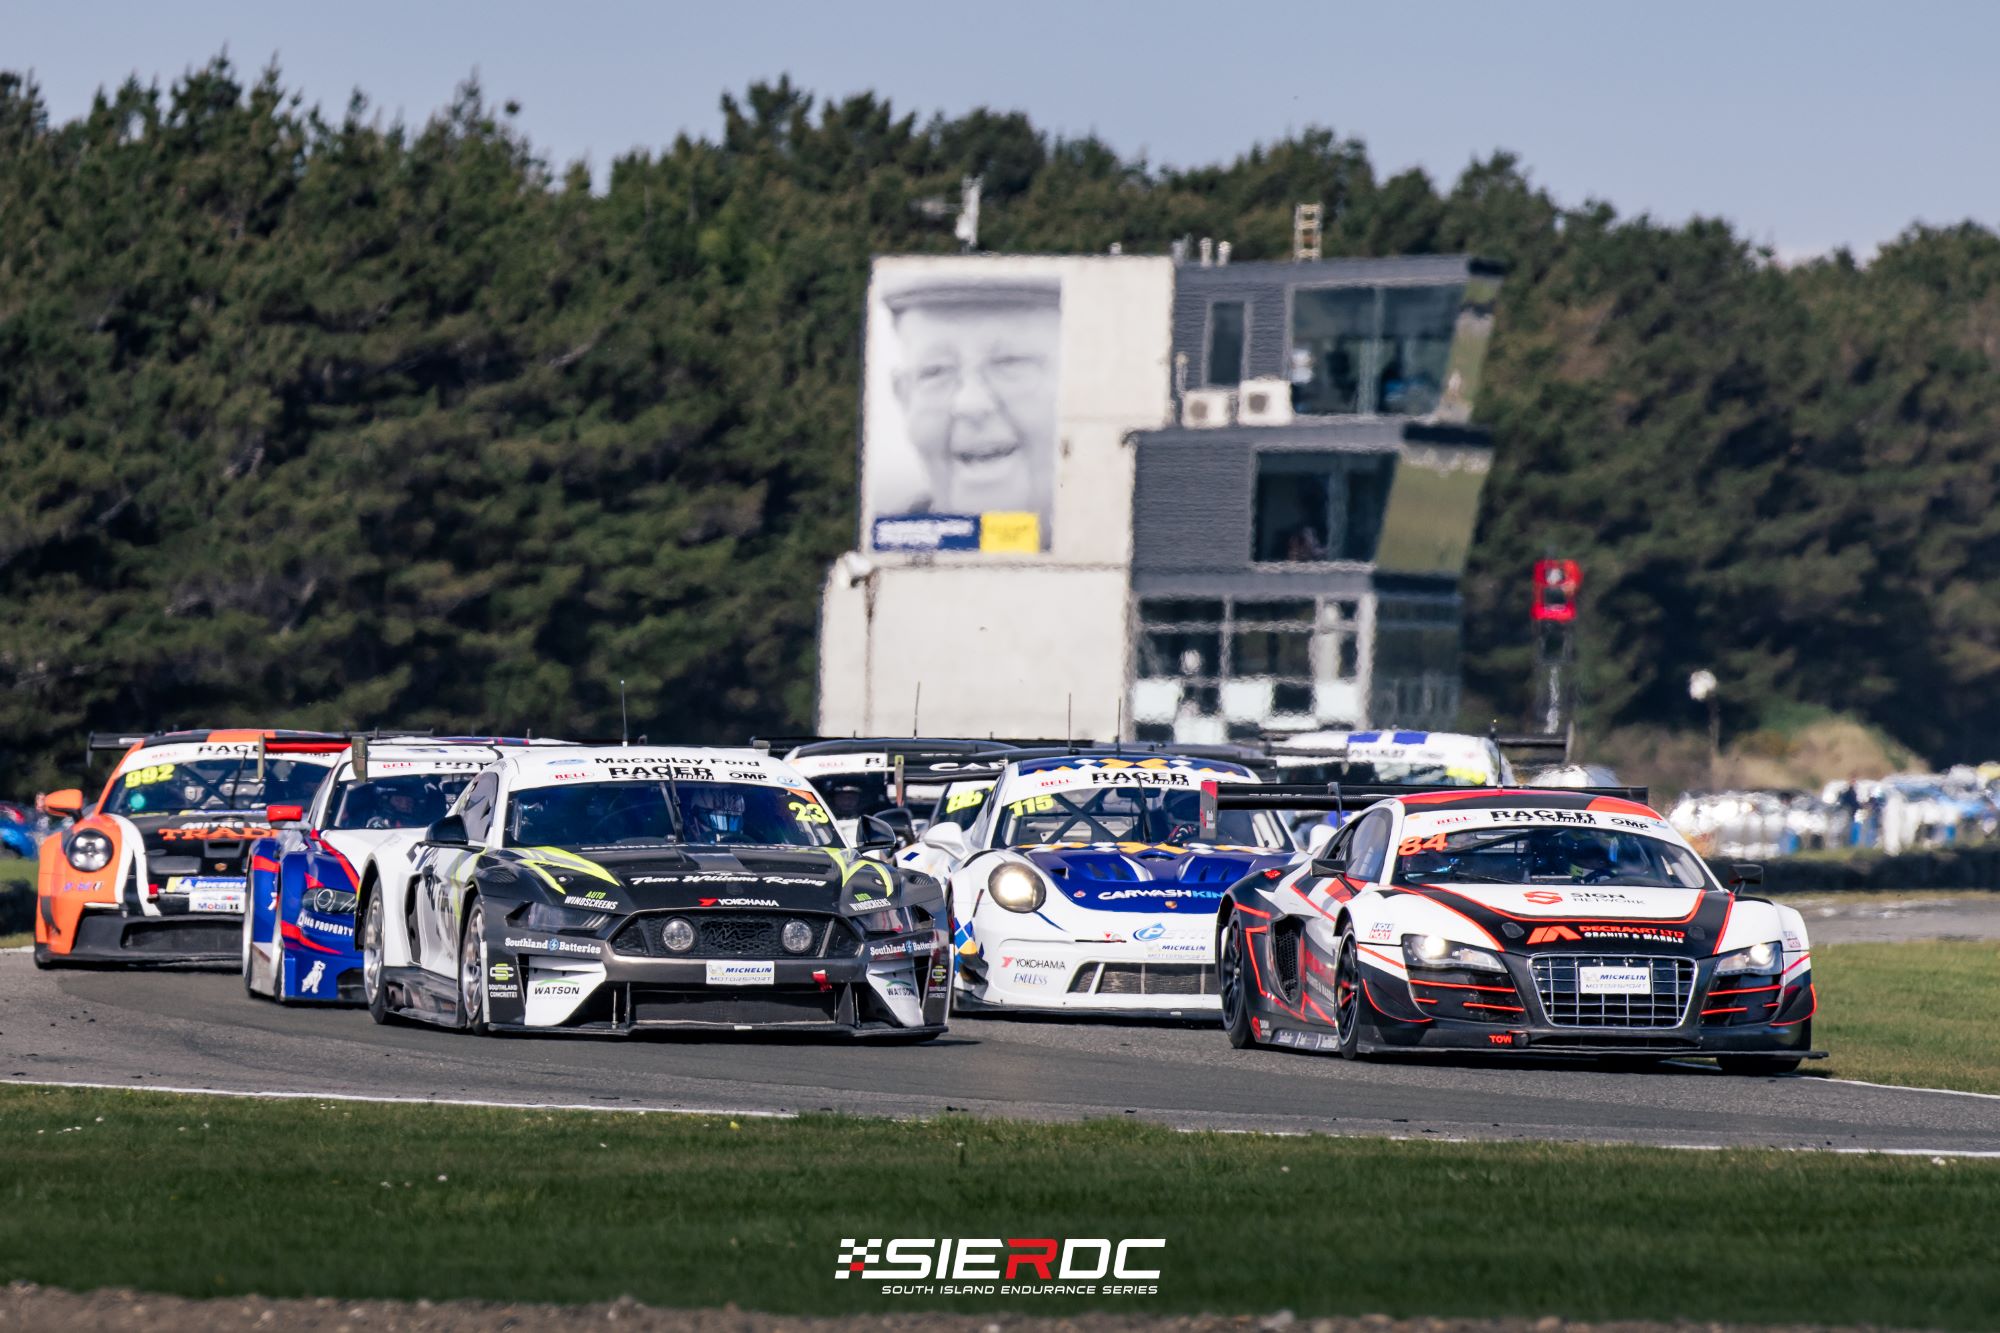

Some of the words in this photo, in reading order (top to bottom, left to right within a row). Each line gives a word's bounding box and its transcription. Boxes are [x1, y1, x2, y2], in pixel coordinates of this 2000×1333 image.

[595, 757, 703, 766] Macaulay
[710, 758, 760, 767] Ford
[125, 763, 175, 788] 992
[555, 772, 586, 780] BELL
[608, 766, 711, 776] RACER
[729, 771, 768, 780] OMP
[1091, 771, 1189, 783] RACER
[1041, 778, 1071, 787] BELL
[1009, 793, 1054, 817] 115
[788, 801, 829, 824] 23
[1490, 809, 1593, 821] RACER
[1436, 815, 1472, 825] BELL
[1610, 817, 1649, 830] OMP
[1398, 832, 1448, 856] 84
[630, 876, 679, 886] Team
[682, 874, 759, 884] Williams
[763, 876, 827, 887] Racing
[585, 890, 606, 900] AUTO
[1572, 897, 1646, 905] NETWORK
[564, 895, 618, 910] WINDSCREENS
[718, 898, 780, 907] YOKOHAMA
[314, 919, 354, 937] PROPERTY
[1660, 928, 1686, 938] LTD
[1584, 931, 1629, 939] GRANITE
[1632, 932, 1640, 940] &
[1643, 933, 1684, 944] MARBLE
[505, 937, 548, 950] Southland
[559, 941, 601, 954] Batteries
[870, 943, 906, 956] Southland
[1161, 944, 1206, 952] MICHELIN
[1016, 958, 1066, 970] YOKOHAMA
[1014, 972, 1048, 985] ENDLESS
[534, 986, 580, 995] WATSON
[1489, 1035, 1512, 1044] TOW
